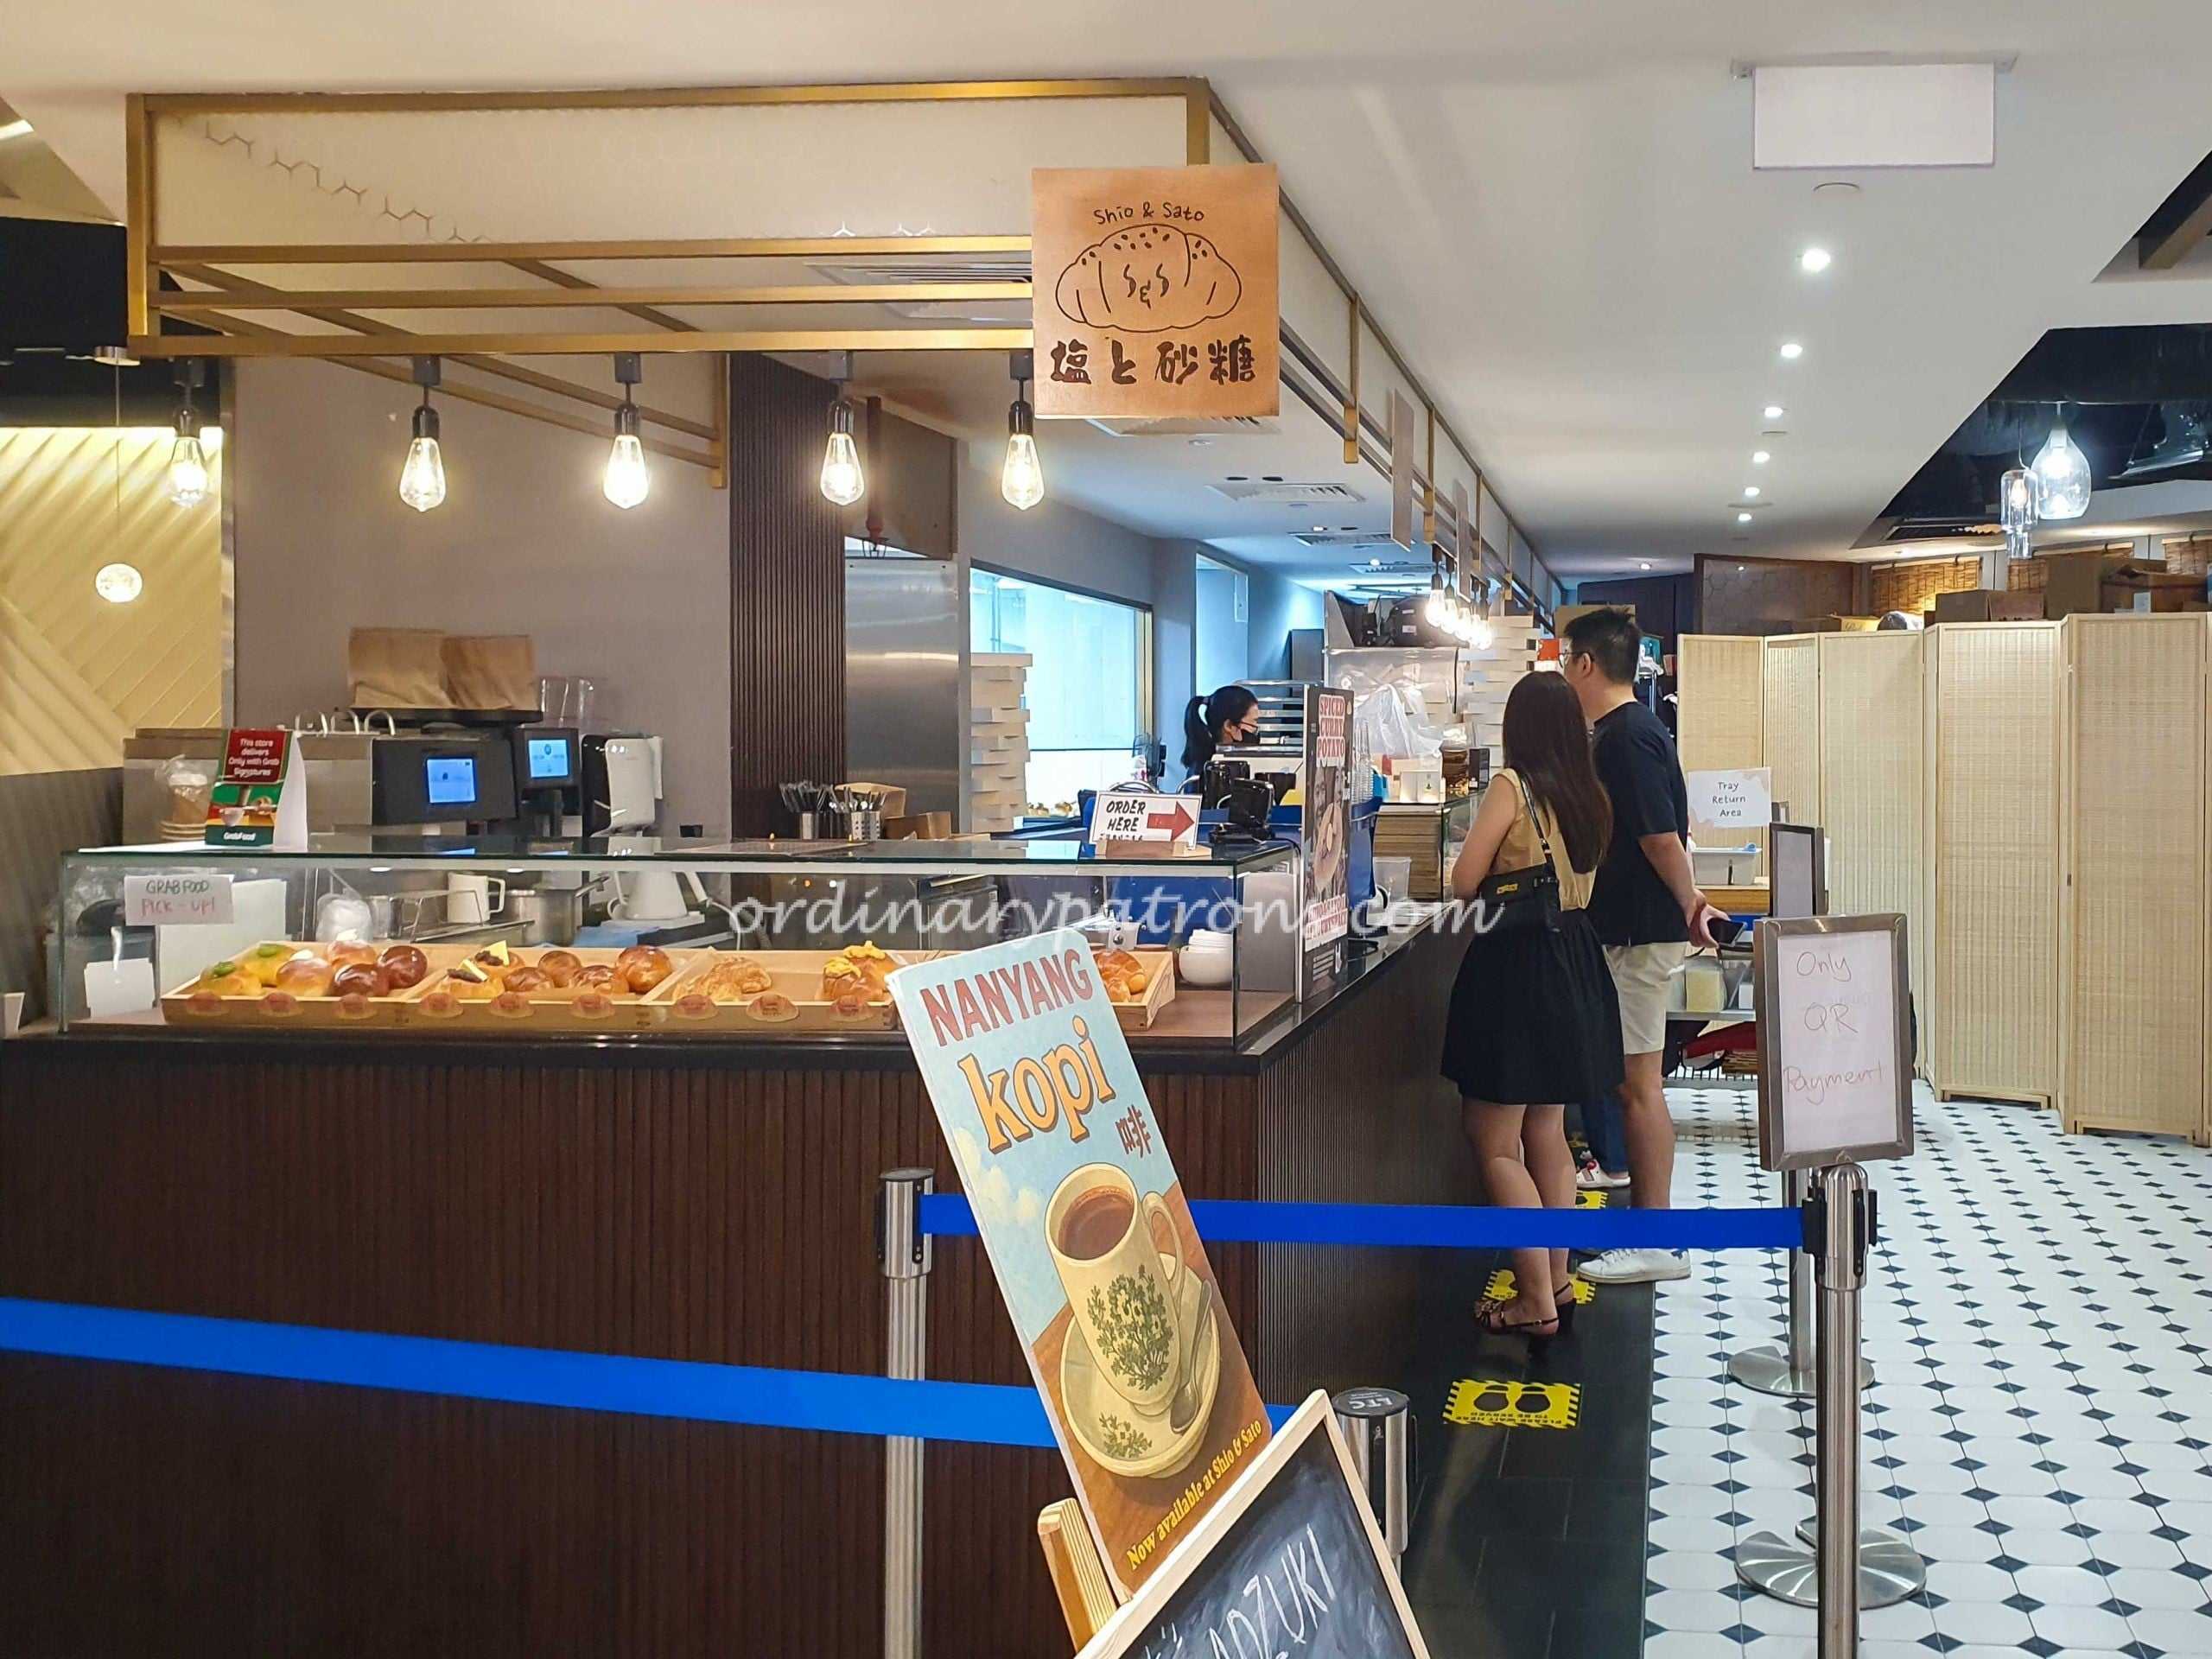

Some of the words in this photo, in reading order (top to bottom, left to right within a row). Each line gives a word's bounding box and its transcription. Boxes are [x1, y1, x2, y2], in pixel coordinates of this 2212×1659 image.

[1093, 206, 1134, 225] Shio
[1142, 201, 1154, 218] &
[1163, 202, 1205, 222] Sato
[1050, 334, 1256, 385] 塩と砂糖
[1319, 696, 1344, 716] SPICED
[1320, 717, 1344, 737] CURRY
[1317, 738, 1345, 758] POTATO
[1718, 781, 1739, 792] Tray
[1106, 799, 1146, 815] ORDER
[1712, 795, 1746, 804] Return
[1107, 817, 1139, 831] HERE
[1796, 951, 1852, 982] Only
[920, 948, 1093, 1047] NANYANG
[1804, 1002, 1859, 1033] QR
[957, 1014, 1116, 1155] kopi
[1116, 1104, 1152, 1159] 啡
[1126, 1530, 1156, 1571] Now
[1156, 1481, 1205, 1541] available
[1203, 1469, 1217, 1491] at
[1212, 1449, 1235, 1479] Shio
[1241, 1420, 1262, 1448] Sato
